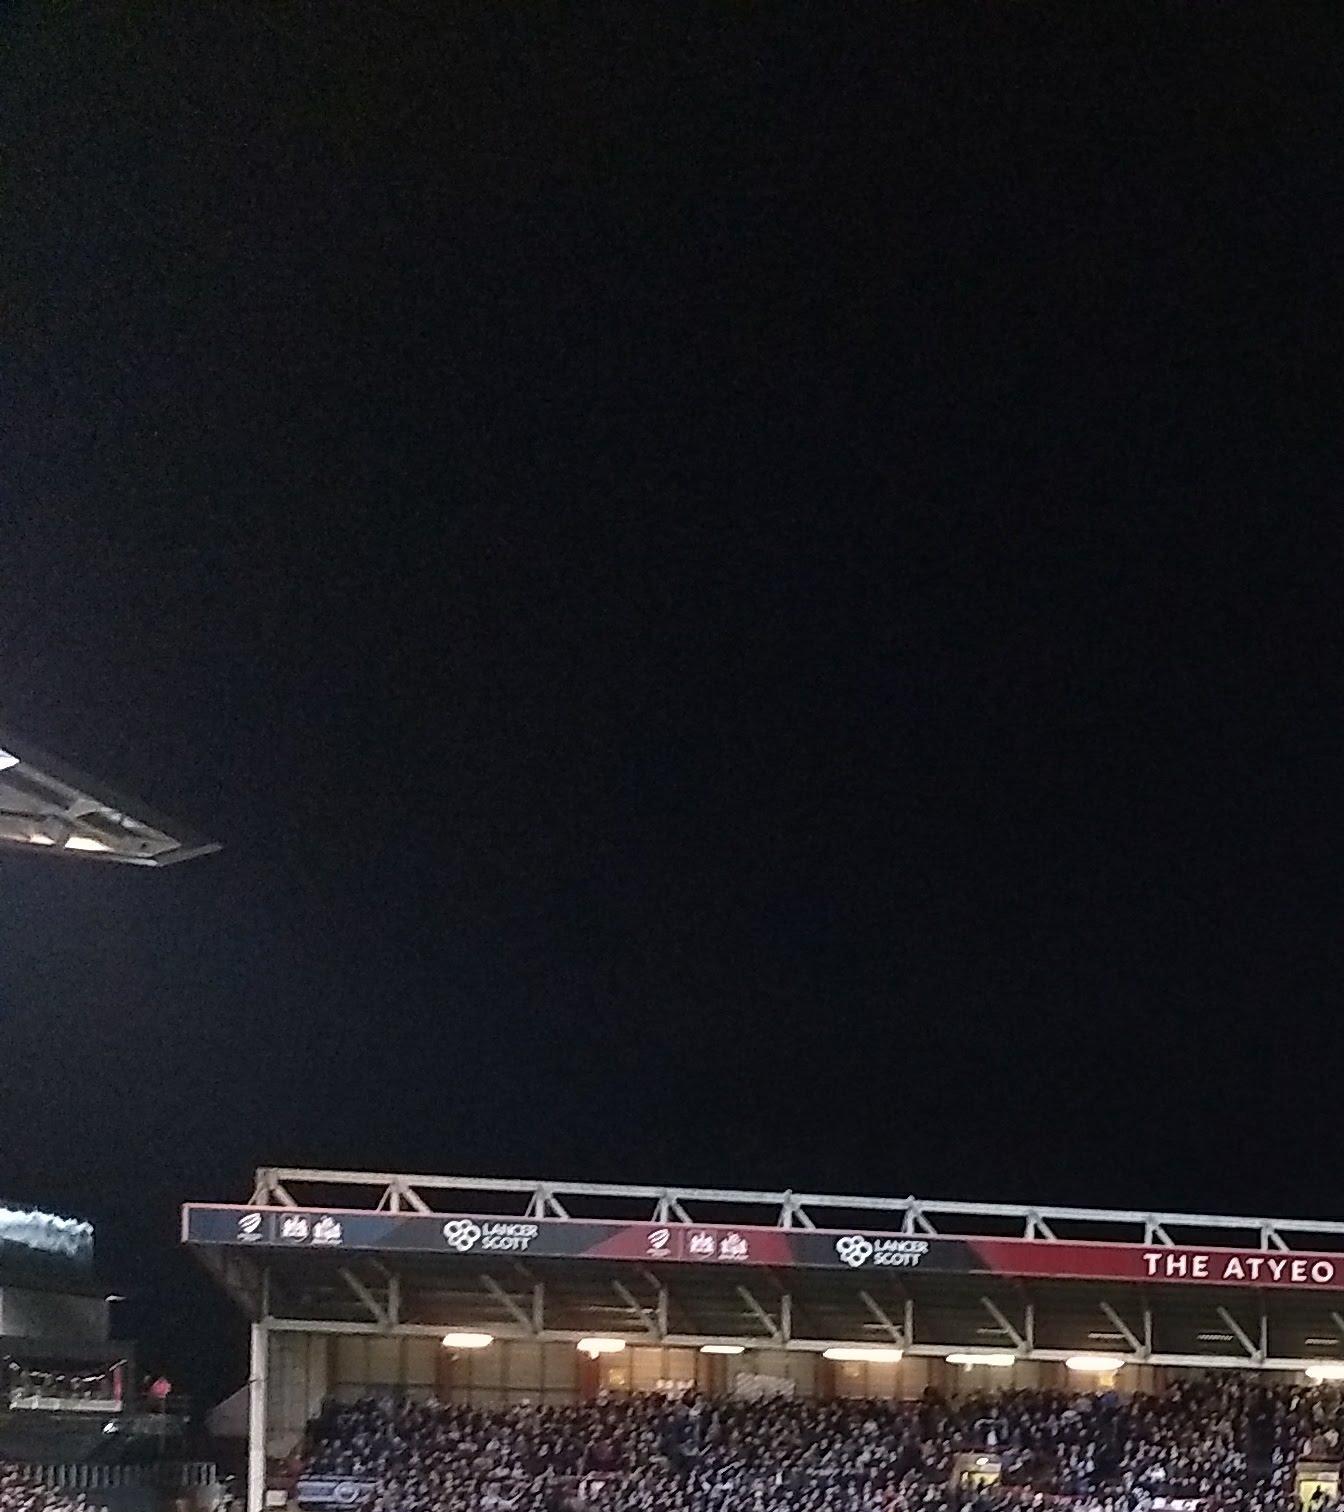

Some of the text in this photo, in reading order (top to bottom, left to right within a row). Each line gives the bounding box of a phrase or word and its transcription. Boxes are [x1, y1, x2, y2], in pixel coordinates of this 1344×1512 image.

[481, 1223, 539, 1238] LANCER
[481, 1236, 532, 1251] SCOTT
[873, 1239, 929, 1254] LANCER
[873, 1252, 921, 1267] SCOTT
[1143, 1253, 1210, 1278] THE
[1222, 1256, 1335, 1283] ATYEO
